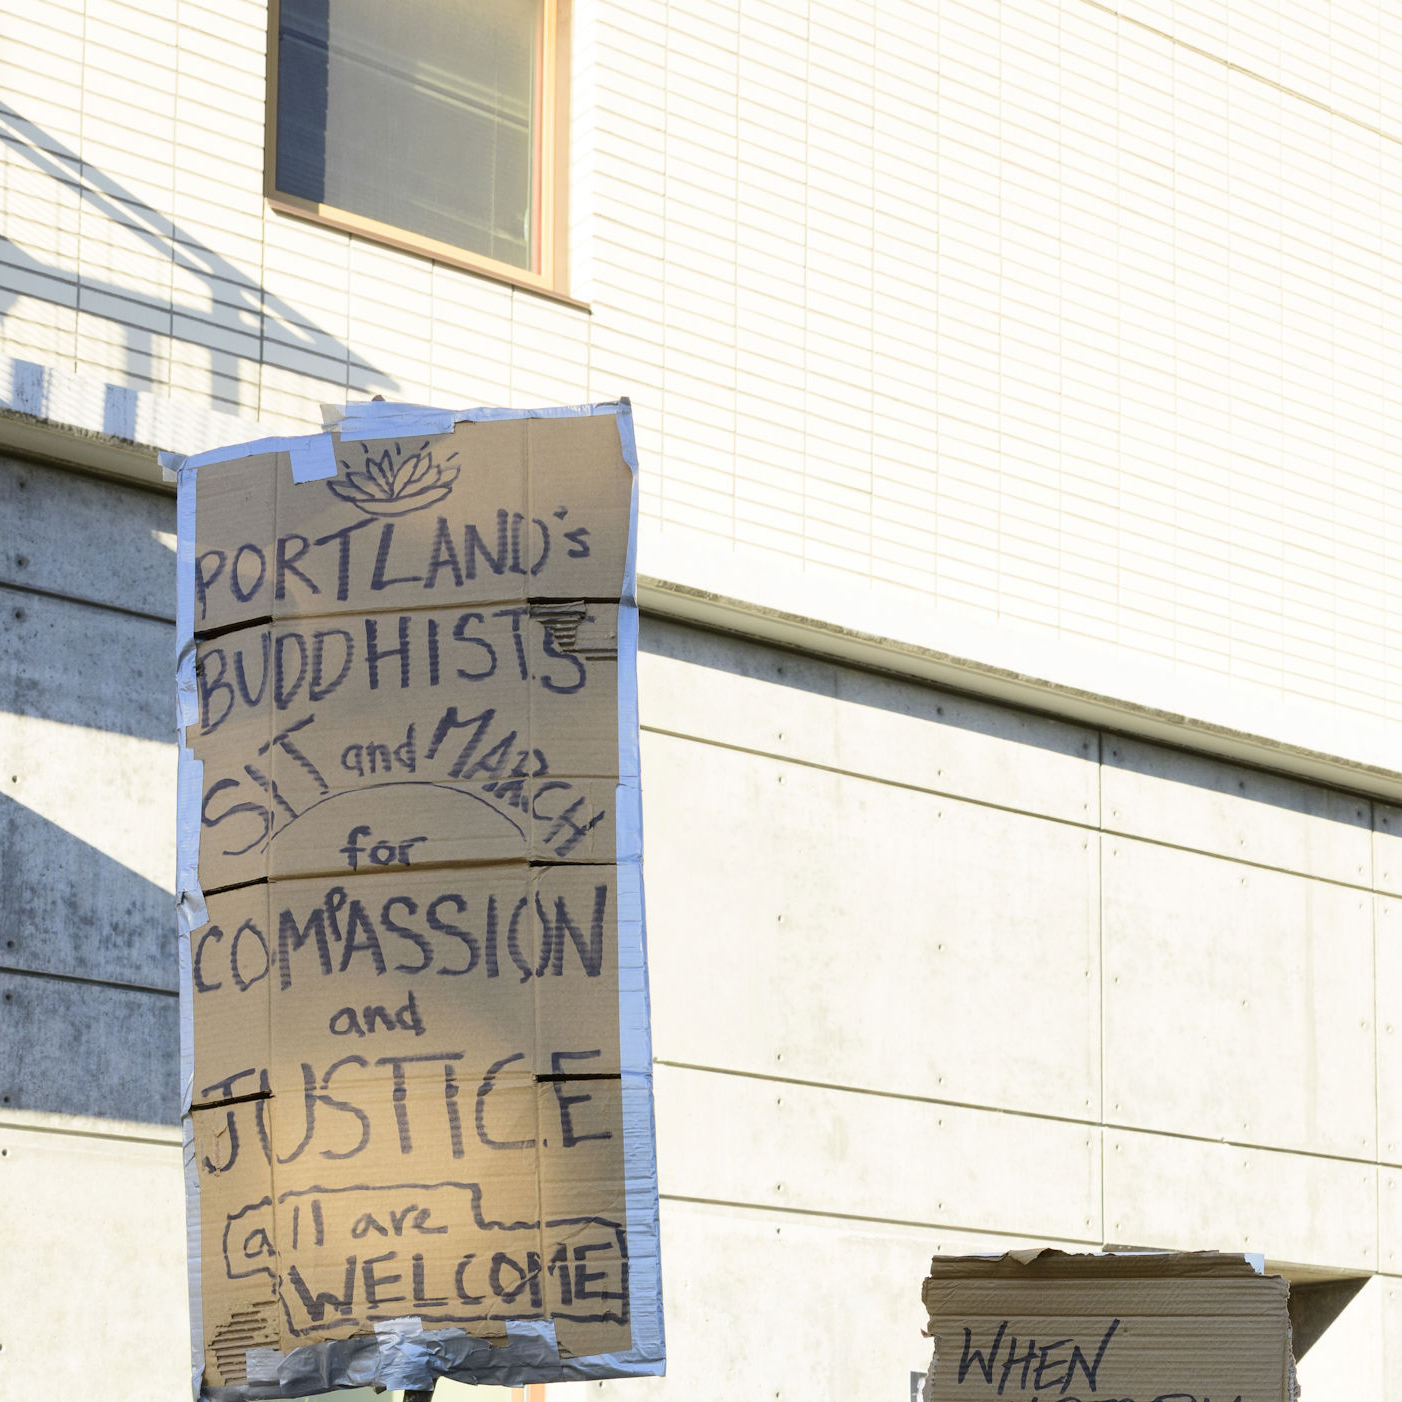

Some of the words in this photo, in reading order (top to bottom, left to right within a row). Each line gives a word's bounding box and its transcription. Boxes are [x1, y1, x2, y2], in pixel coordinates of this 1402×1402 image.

[196, 606, 596, 736] BUDDHISTS
[201, 714, 330, 857] SIT
[340, 723, 417, 777] and
[425, 706, 605, 858] MARCH
[340, 826, 428, 872] for
[193, 885, 607, 992] COMPASSION
[328, 989, 427, 1038] and
[200, 1049, 614, 1175] JUSTICE
[242, 1199, 326, 1259] all
[351, 1203, 448, 1240] are
[287, 1242, 620, 1322] WELCOME
[958, 1319, 1120, 1395] WHEN
